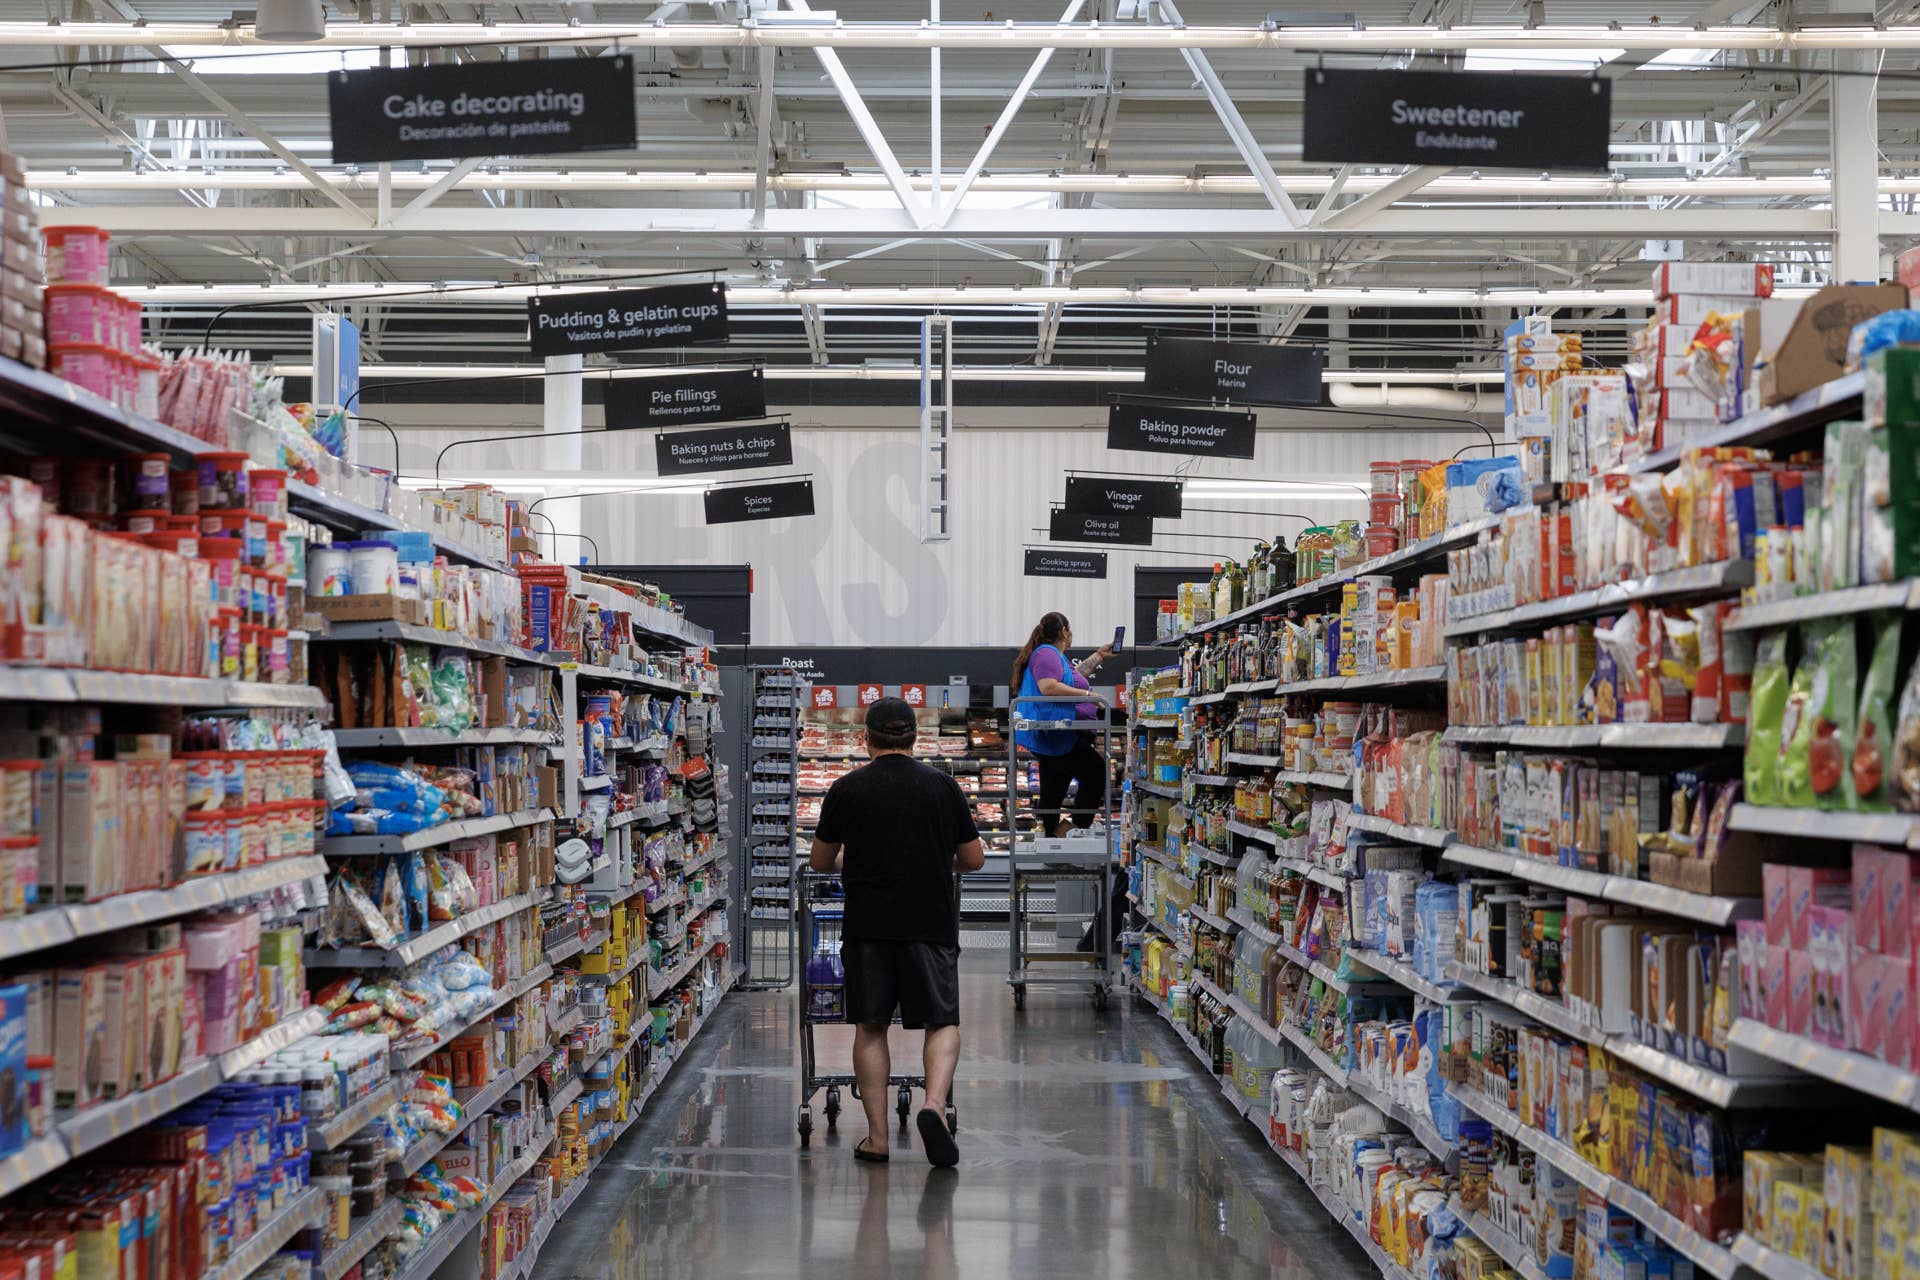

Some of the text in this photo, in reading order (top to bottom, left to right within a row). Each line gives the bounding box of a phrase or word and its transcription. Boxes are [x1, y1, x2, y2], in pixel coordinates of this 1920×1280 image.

[383, 88, 584, 119] Cake decorating
[1392, 99, 1524, 128] Sweetener
[487, 121, 508, 137] de
[510, 118, 571, 139] pasteles
[1416, 131, 1498, 150] Endulzante
[539, 304, 719, 328] Pudding & gelatin cups
[567, 331, 601, 342] Vasitos
[603, 329, 616, 339] de
[645, 329, 652, 338] y
[654, 323, 692, 337] gelatina
[1214, 360, 1252, 375] Flour
[1217, 378, 1246, 388] Harina
[651, 389, 717, 403] Pie fillings
[649, 404, 721, 416] Rellenos para tarta
[1140, 419, 1227, 437] Baking powder
[671, 437, 776, 455] Baking nuts & chips
[1149, 434, 1215, 447] Polvo para hornear
[710, 454, 727, 463] chips
[728, 453, 743, 462] para
[743, 451, 769, 459] hornear
[744, 496, 772, 506] Spices
[1105, 490, 1143, 503] Vinegar
[1112, 503, 1134, 511] Vinagre
[1085, 520, 1119, 529] Olive oil
[1041, 557, 1091, 568] Cooking sprays
[782, 657, 814, 668] Roast
